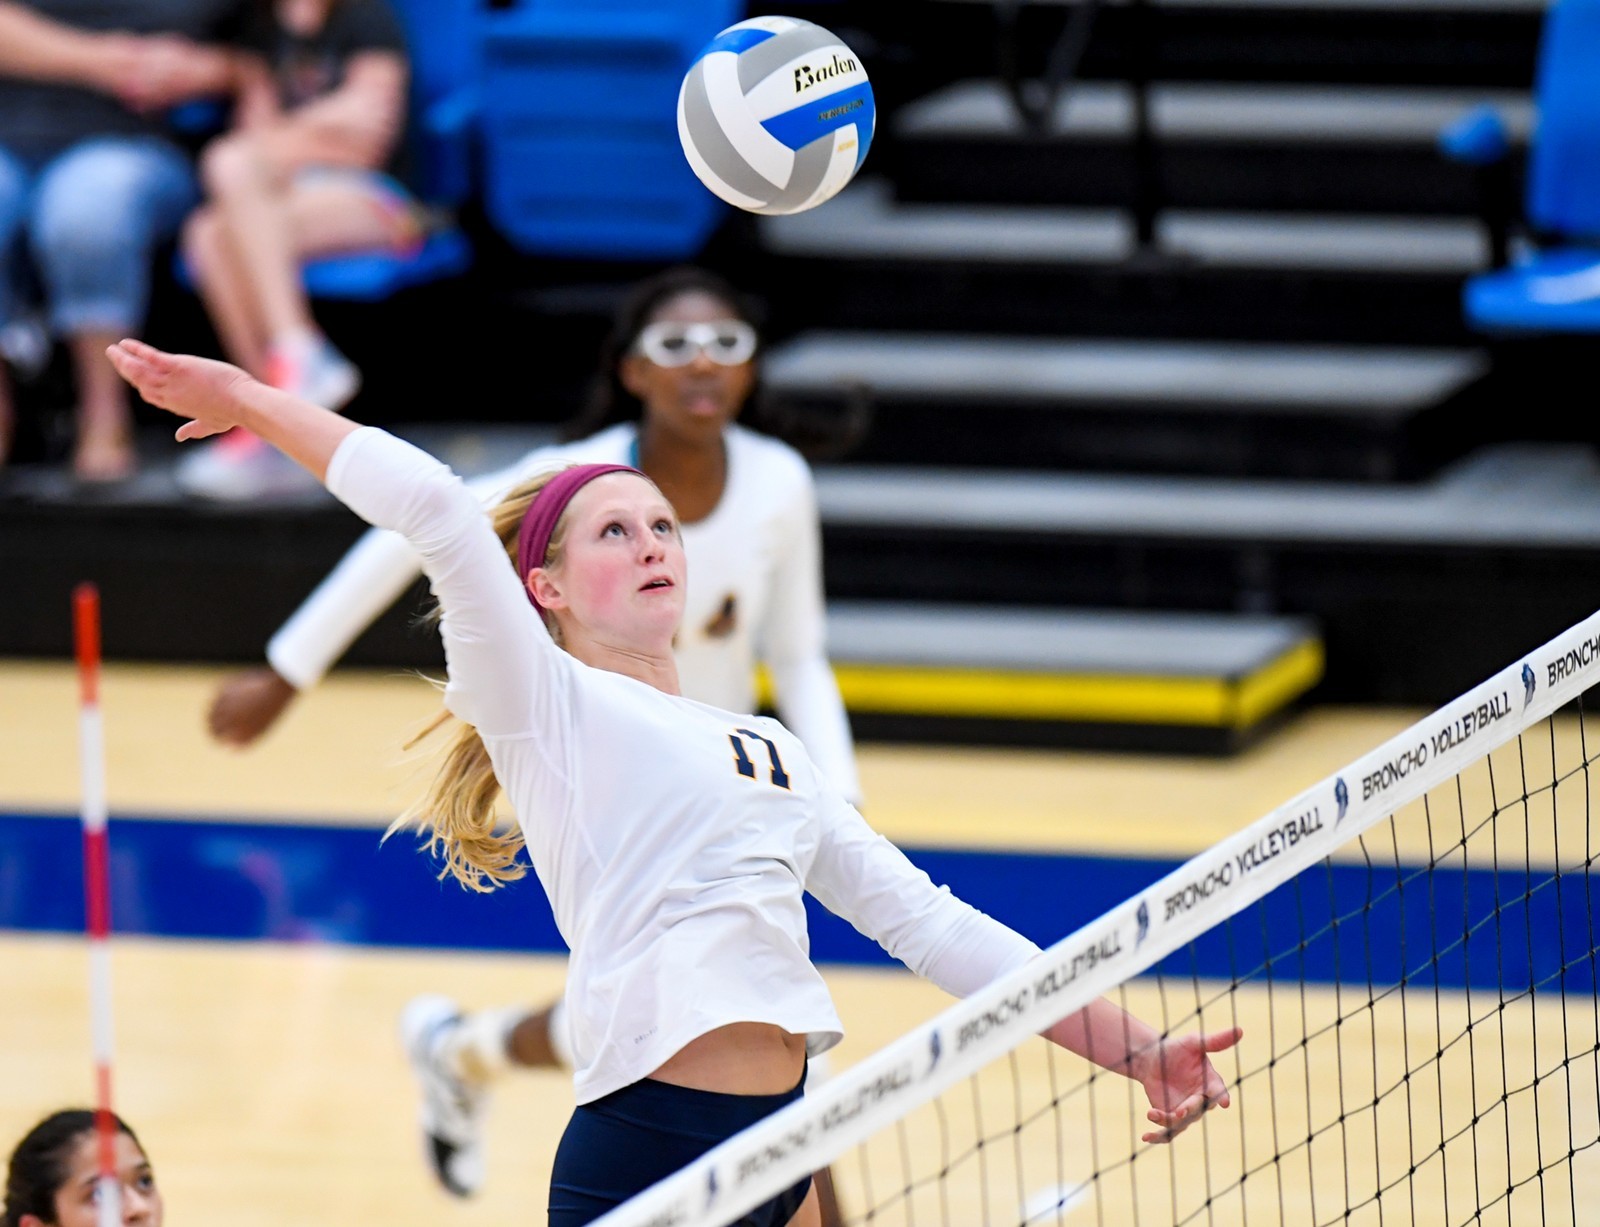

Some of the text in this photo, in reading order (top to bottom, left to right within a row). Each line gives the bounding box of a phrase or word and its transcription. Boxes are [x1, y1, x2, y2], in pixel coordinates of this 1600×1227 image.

[793, 54, 857, 93] Baden
[1547, 633, 1600, 687] BRONCH
[1362, 691, 1512, 801] BRONCHO VOLLEYBALL
[1164, 807, 1323, 922] BRONCHO VOLLEYBALL
